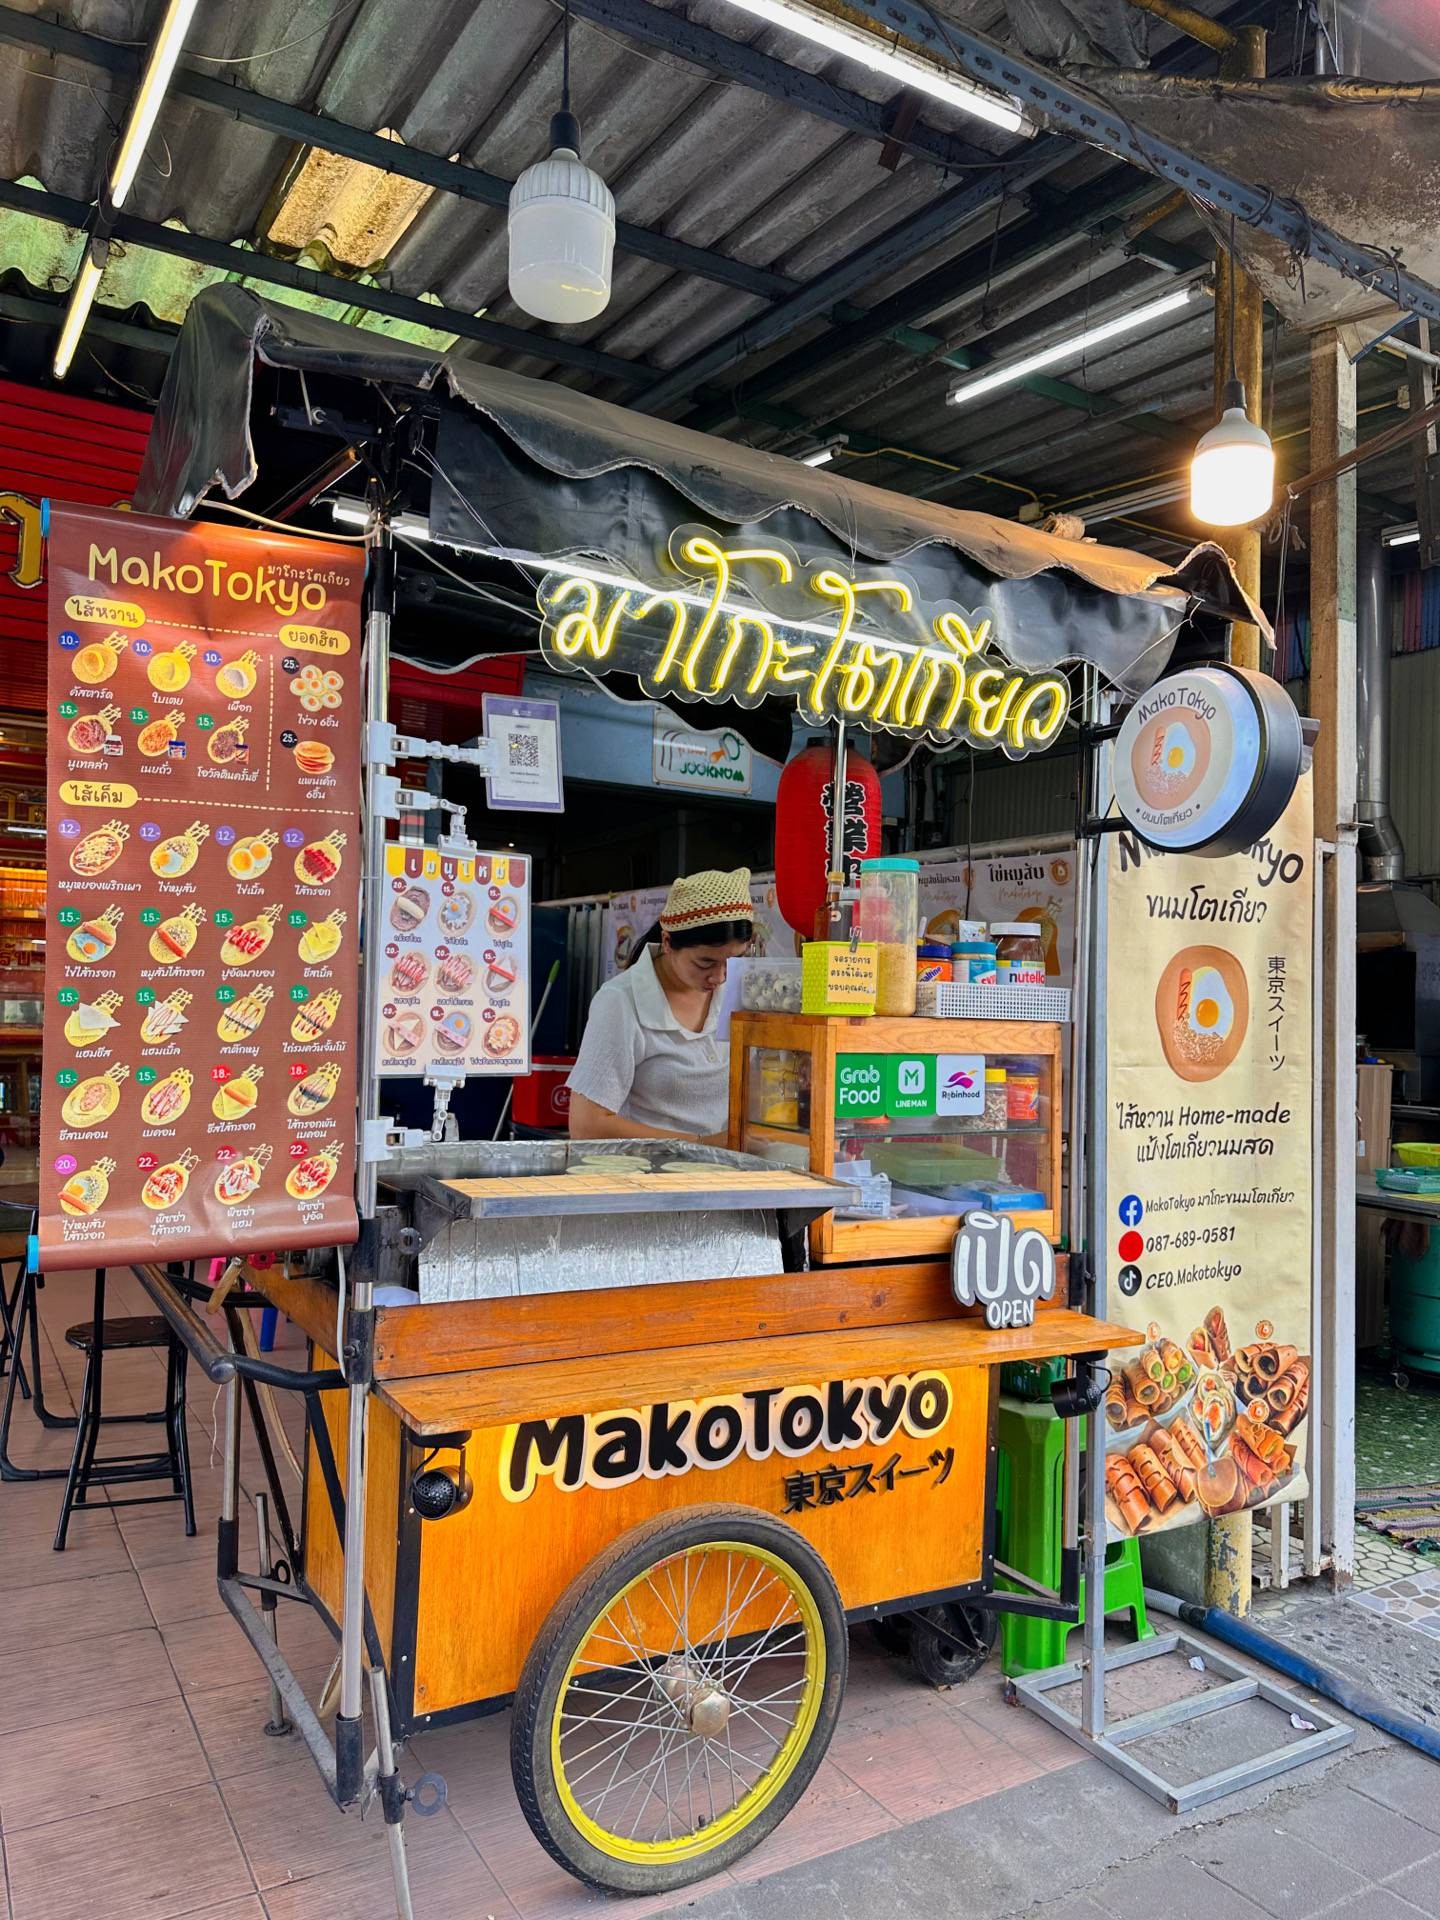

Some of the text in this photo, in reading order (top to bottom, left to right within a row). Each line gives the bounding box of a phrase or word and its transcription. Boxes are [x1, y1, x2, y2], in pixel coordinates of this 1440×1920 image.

[88, 543, 326, 616] MakoTokyo
[268, 564, 350, 586] มาโกะโตเกียว
[71, 598, 138, 623] ไส้หวาน
[289, 629, 339, 648] ยอดฮิต
[552, 536, 1065, 749] มาโกะโตเกียว
[152, 692, 183, 705] ใบเตย
[228, 701, 252, 712] เผือก
[140, 761, 172, 775] เนยถั่ว
[70, 785, 123, 803] ไส้เค็ม
[1141, 807, 1193, 826] ขนมโตเกียว
[988, 863, 1045, 886] ไข่หมูสับ
[295, 885, 330, 896] ไส้กรอก
[1146, 885, 1268, 923] ขนมโตเกียว
[1267, 956, 1287, 1071] 東京スイーツ
[840, 1065, 880, 1084] Grab
[839, 1086, 880, 1105] Food
[1116, 1102, 1291, 1130] ไส้หวาน Home-made
[143, 1128, 176, 1137] เบคอน
[297, 1129, 326, 1138] เบคอน
[1137, 1131, 1274, 1162] แป้งโตเกียวนมสด
[1145, 1187, 1295, 1213] MakoTokyo มาโกะขนมโตเกียว
[64, 1230, 105, 1241] ไส้กรอก
[1146, 1226, 1235, 1252] 087-689-0581
[957, 1211, 1053, 1300] เปิด
[988, 1299, 1034, 1326] OPEN
[507, 1372, 952, 1494] MakoTokyo
[782, 1446, 956, 1514] 東京スイーツ
